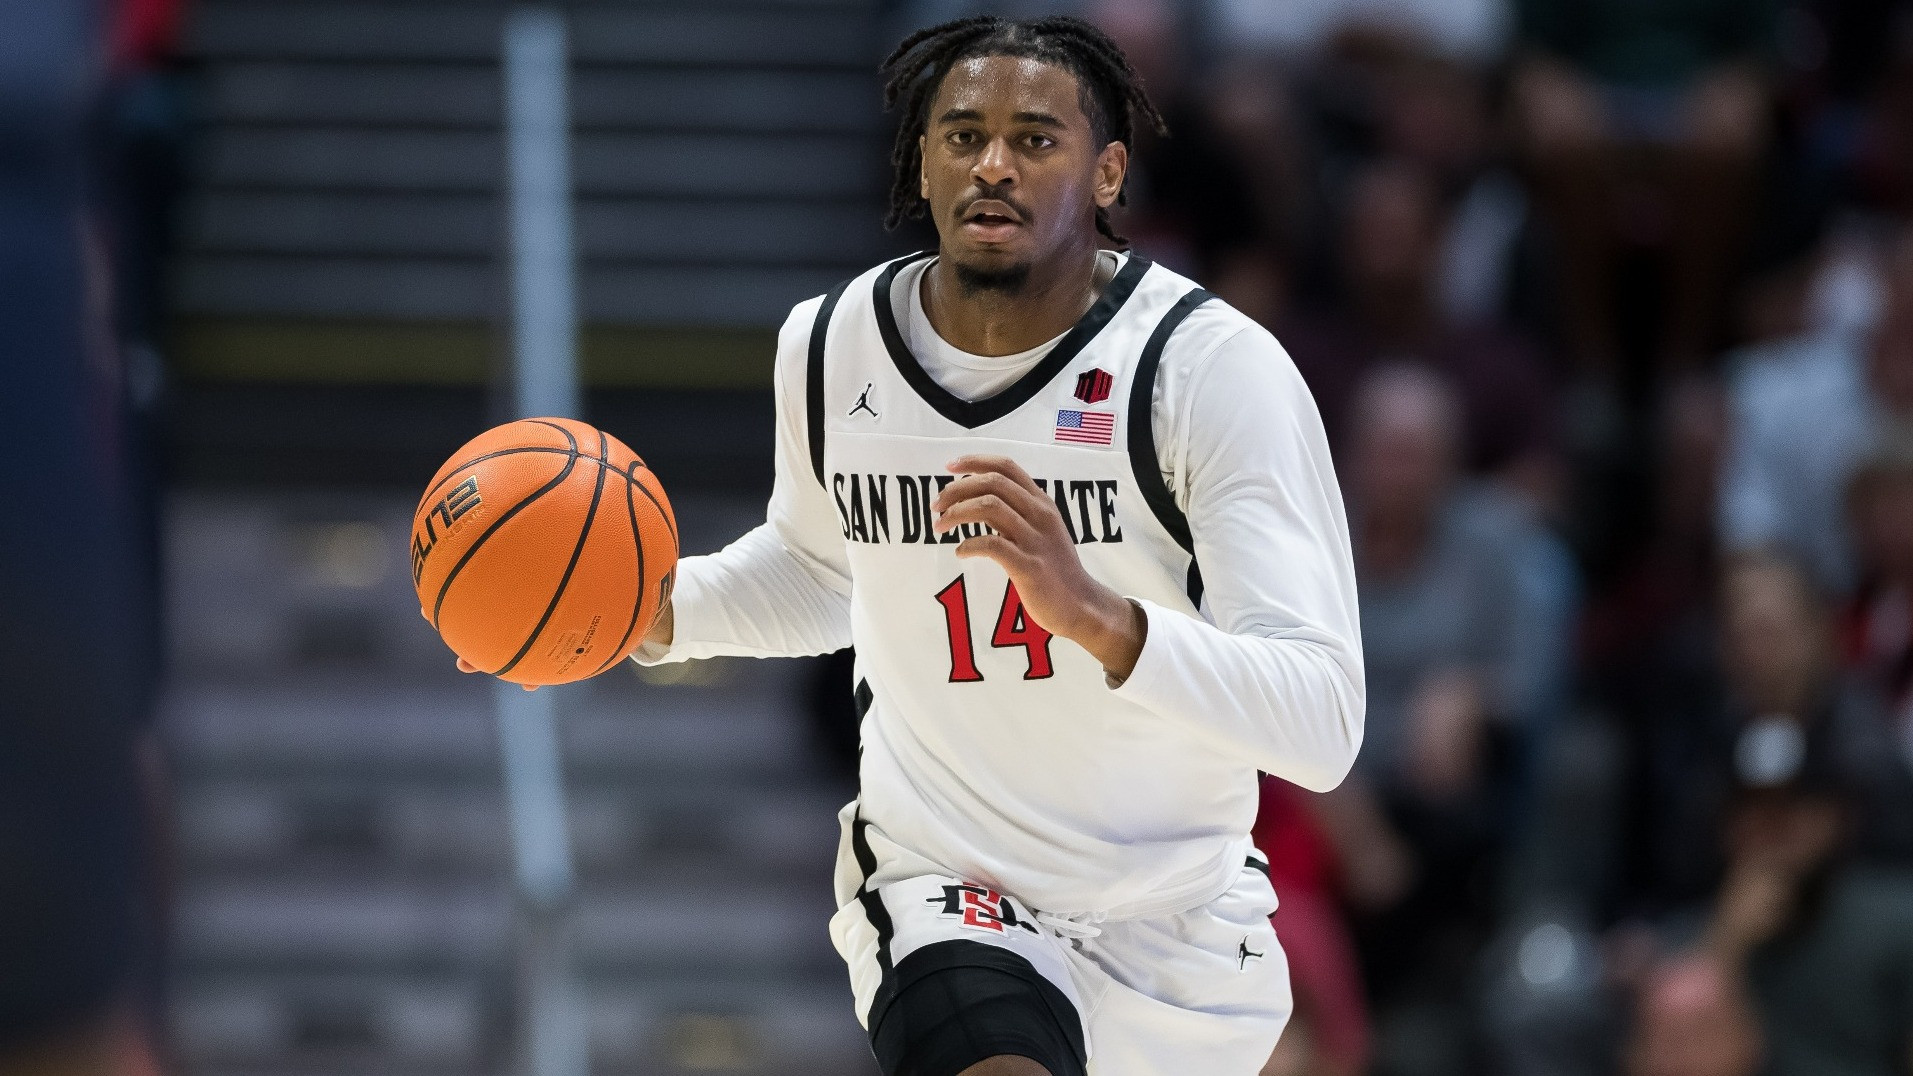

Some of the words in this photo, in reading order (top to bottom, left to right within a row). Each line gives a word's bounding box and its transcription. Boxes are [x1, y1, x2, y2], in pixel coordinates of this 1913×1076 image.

[412, 475, 482, 588] ELITE
[833, 472, 890, 544] SAN
[1032, 478, 1123, 543] ATE
[934, 573, 1054, 683] 14
